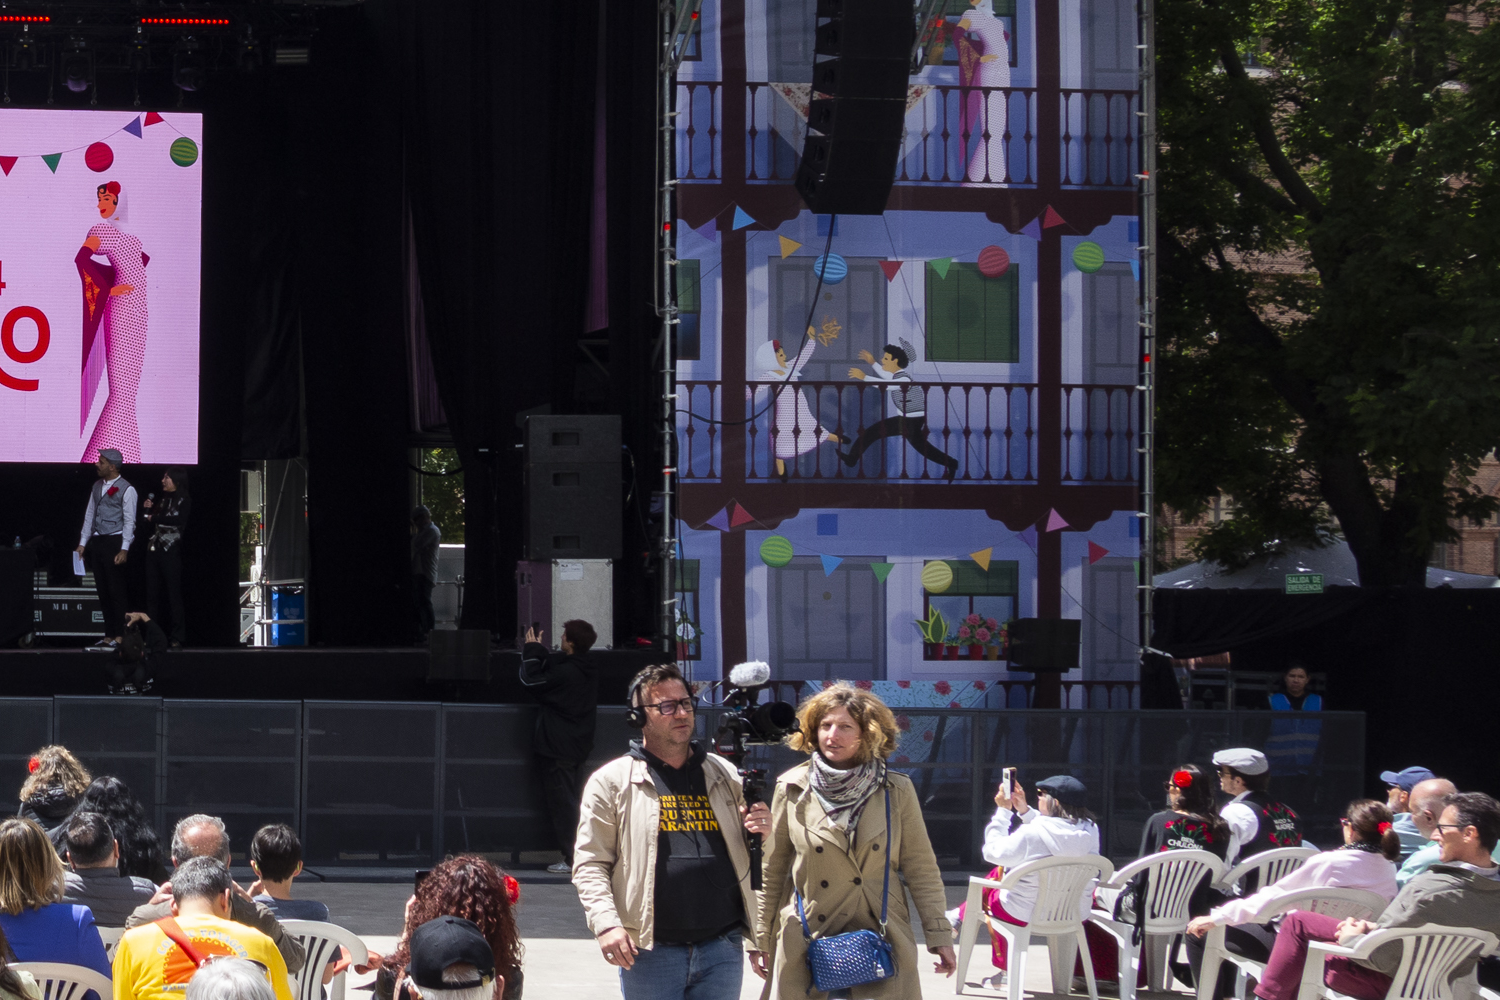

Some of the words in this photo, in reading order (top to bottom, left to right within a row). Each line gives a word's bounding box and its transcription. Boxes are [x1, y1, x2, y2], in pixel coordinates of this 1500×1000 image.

[1287, 576, 1310, 584] SALIDA
[1287, 583, 1322, 591] EMERGENCIA
[658, 820, 719, 831] ARANTIN
